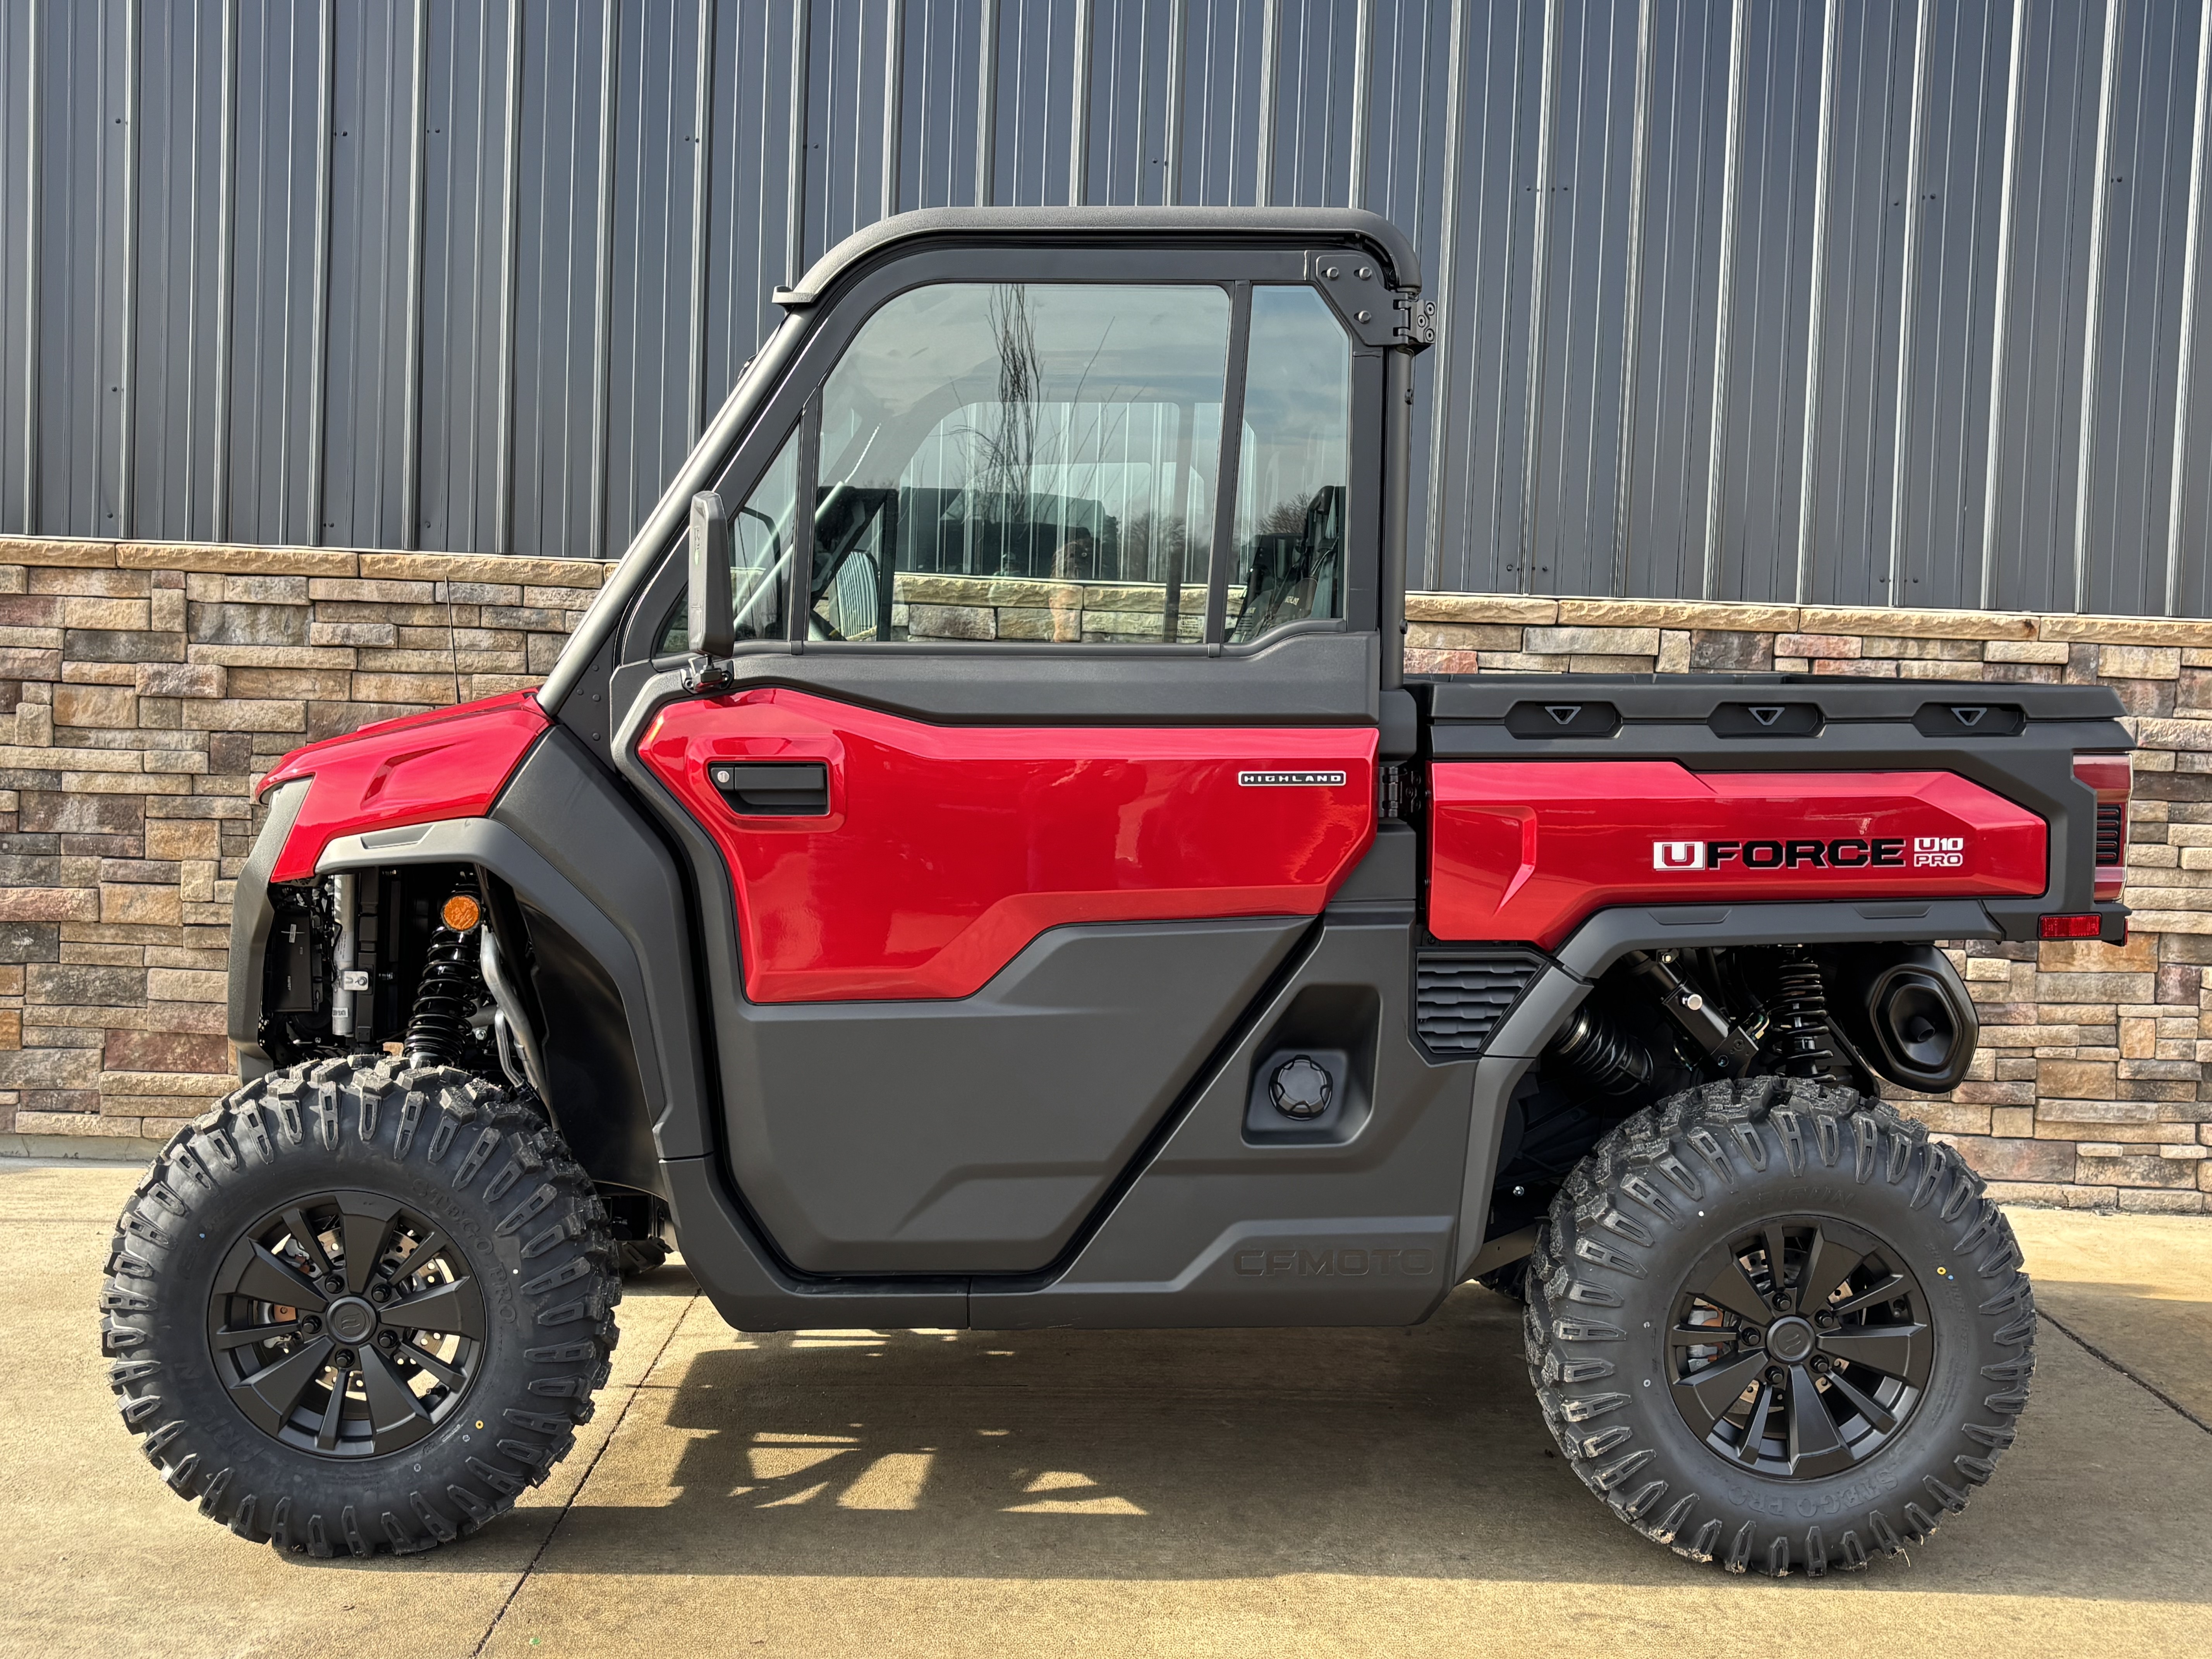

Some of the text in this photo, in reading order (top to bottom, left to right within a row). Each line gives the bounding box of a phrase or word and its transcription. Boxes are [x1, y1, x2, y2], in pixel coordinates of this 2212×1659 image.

[1914, 837, 1963, 852] U10
[1914, 853, 1963, 867] PRO
[412, 1178, 517, 1324] STEGO PRO
[1234, 1249, 1433, 1276] CFMOTO
[174, 1362, 266, 1463] ARISN
[1728, 1470, 1898, 1518] STEGO PRO
